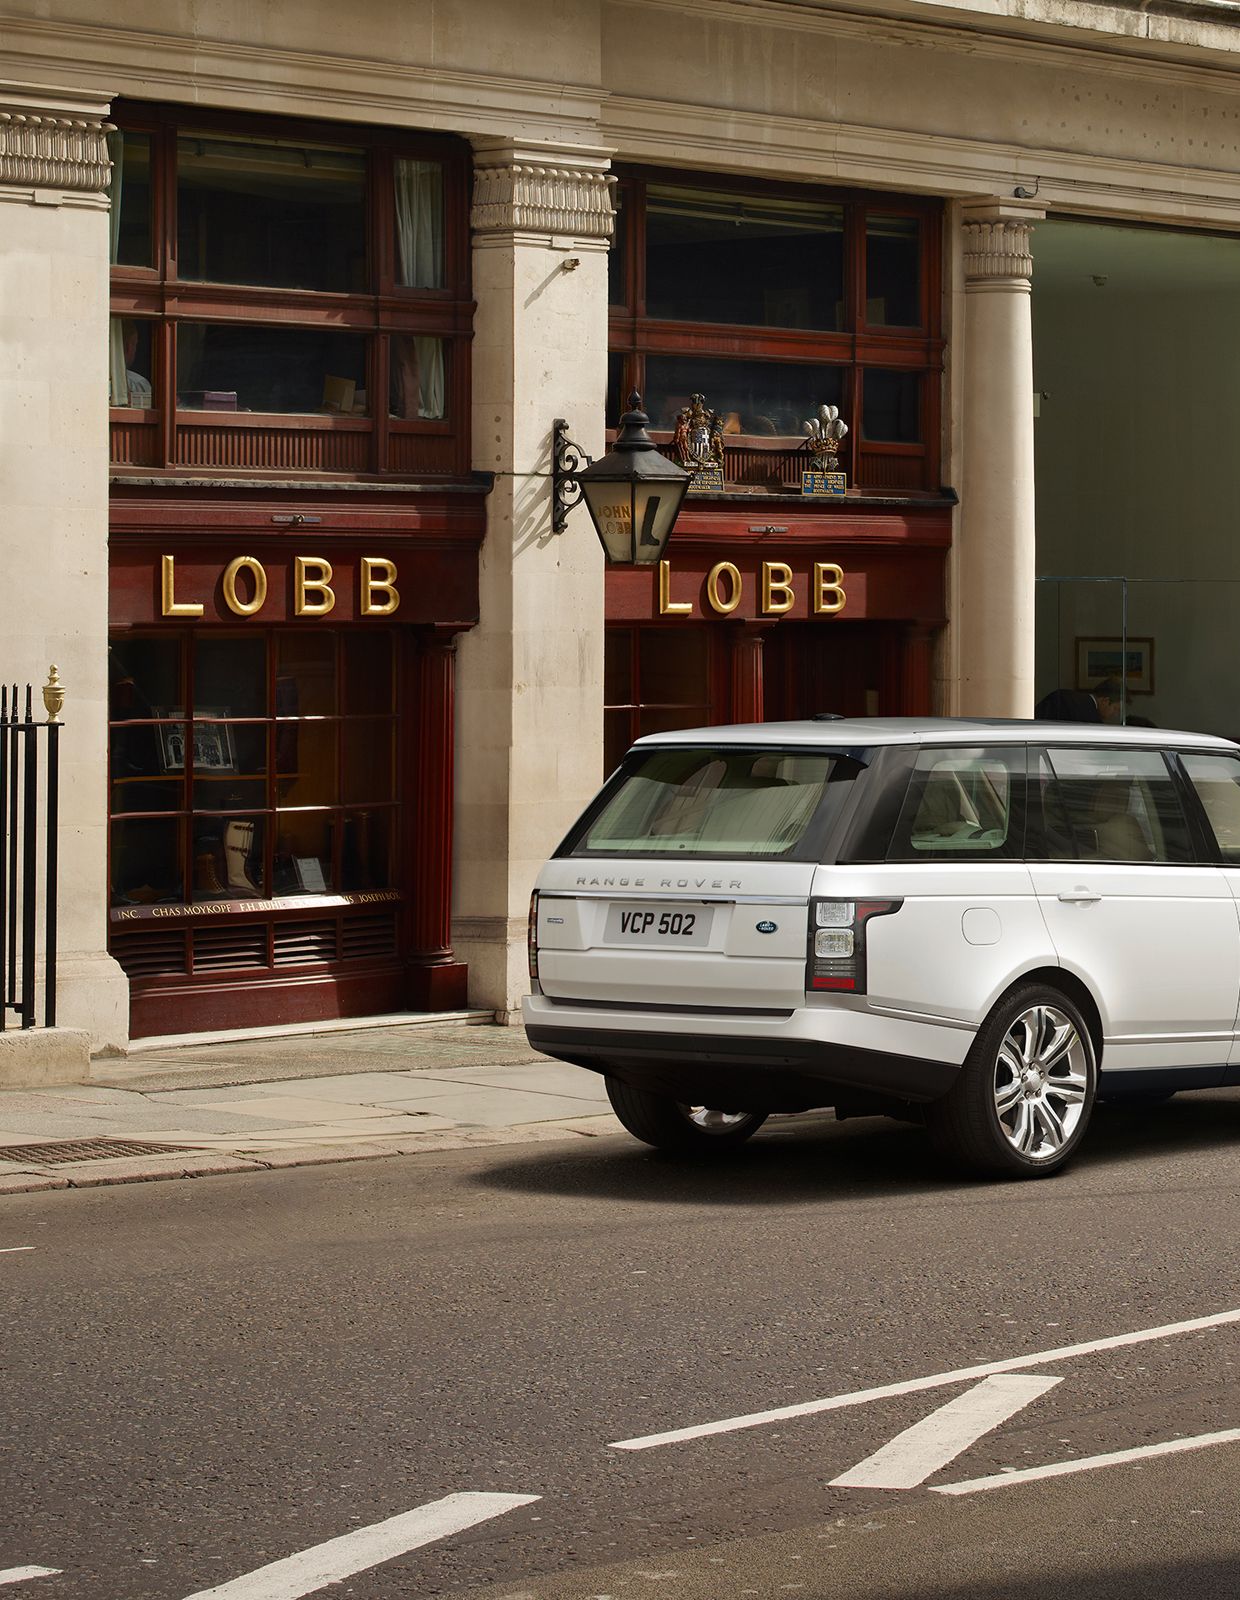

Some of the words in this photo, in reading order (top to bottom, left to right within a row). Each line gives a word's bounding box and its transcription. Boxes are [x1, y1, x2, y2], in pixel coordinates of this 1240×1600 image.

[596, 505, 631, 519] JOHN
[161, 555, 400, 616] LOBB
[659, 559, 847, 614] LOBB
[576, 876, 646, 887] RANGE
[660, 878, 743, 889] ROVER
[358, 892, 386, 904] JOSEPH
[152, 907, 181, 918] CHAS
[183, 903, 232, 916] MOYKOPF
[620, 911, 655, 934] VCP
[657, 913, 696, 935] 502
